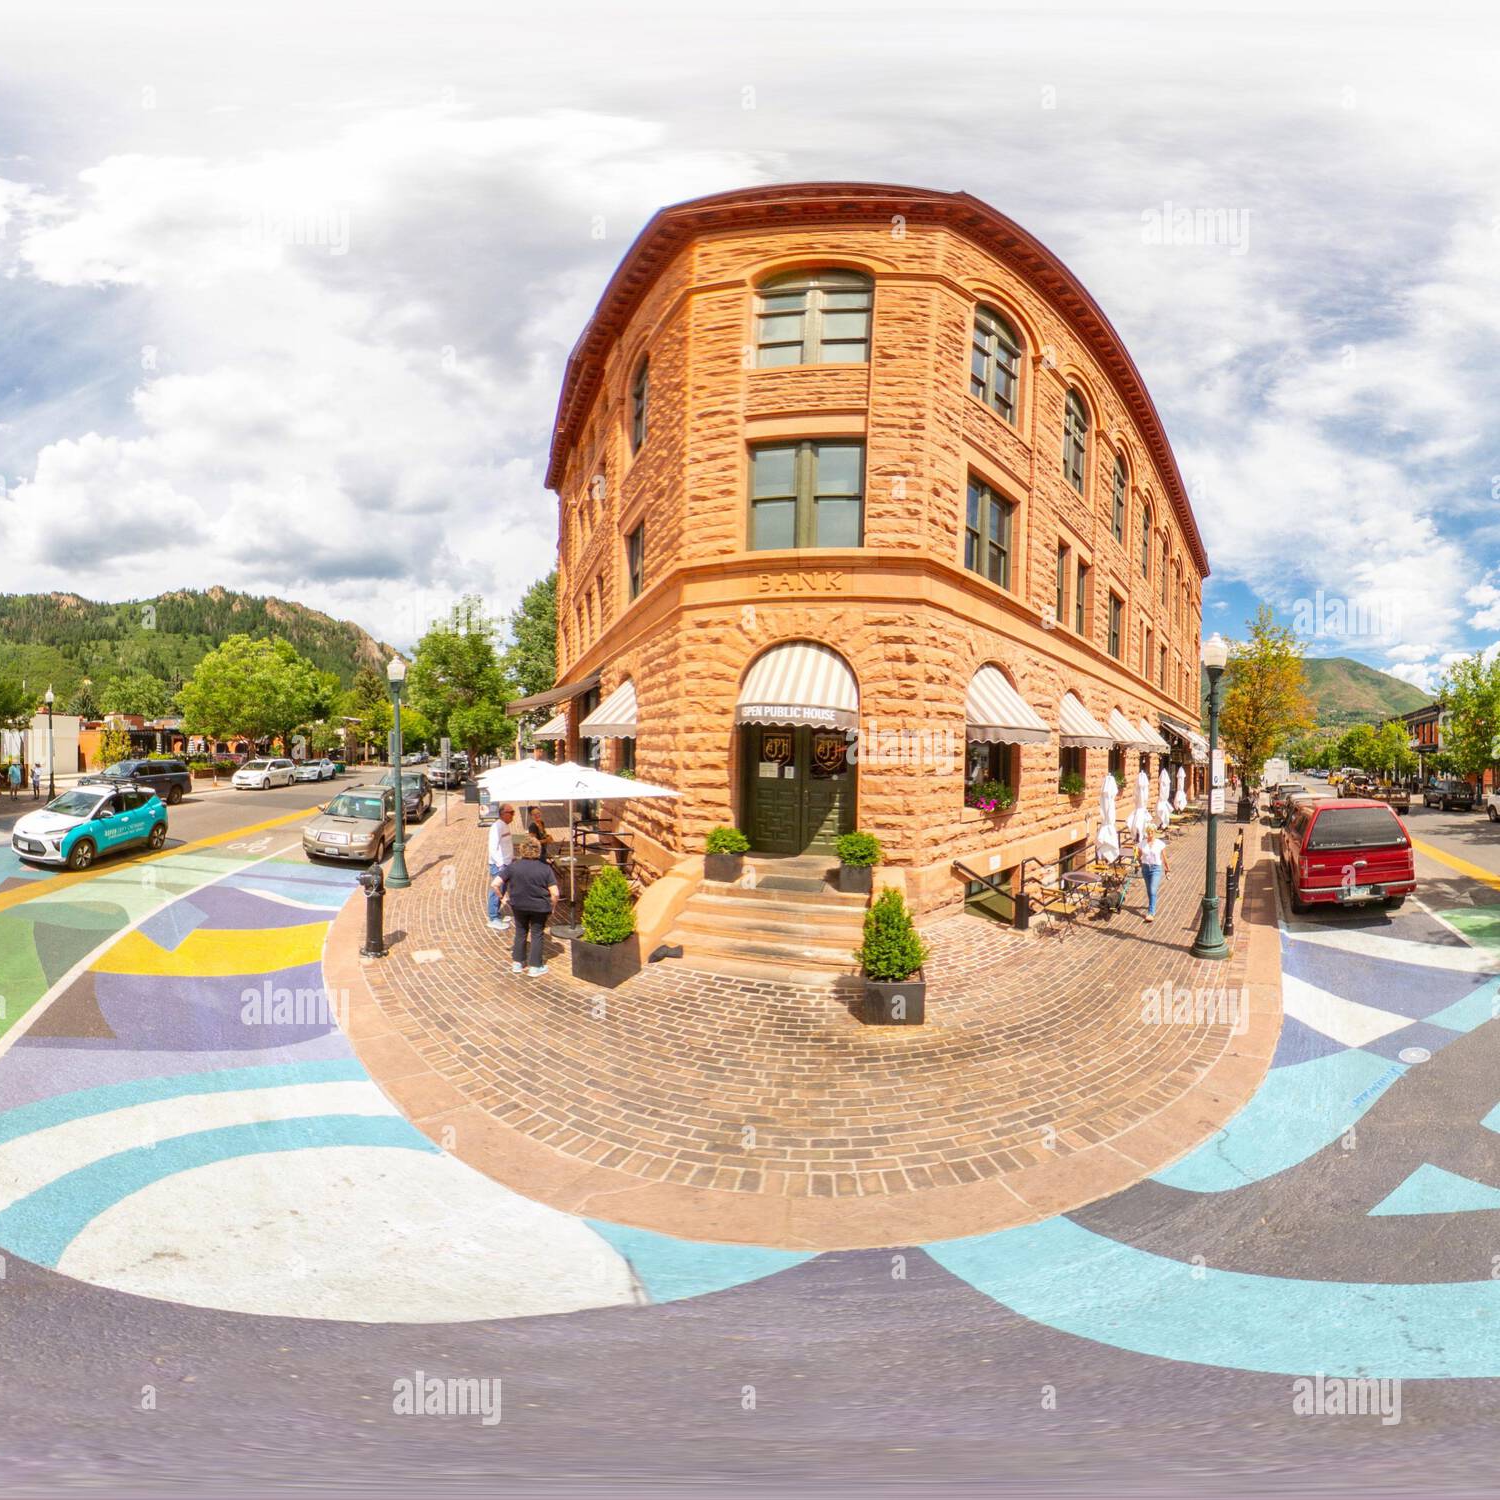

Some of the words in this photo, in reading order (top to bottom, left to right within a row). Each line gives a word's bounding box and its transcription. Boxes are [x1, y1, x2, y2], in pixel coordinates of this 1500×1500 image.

[758, 571, 842, 592] BANK
[741, 705, 764, 717] SPEN
[764, 706, 801, 718] PUBLIC
[803, 707, 836, 721] HOUSE
